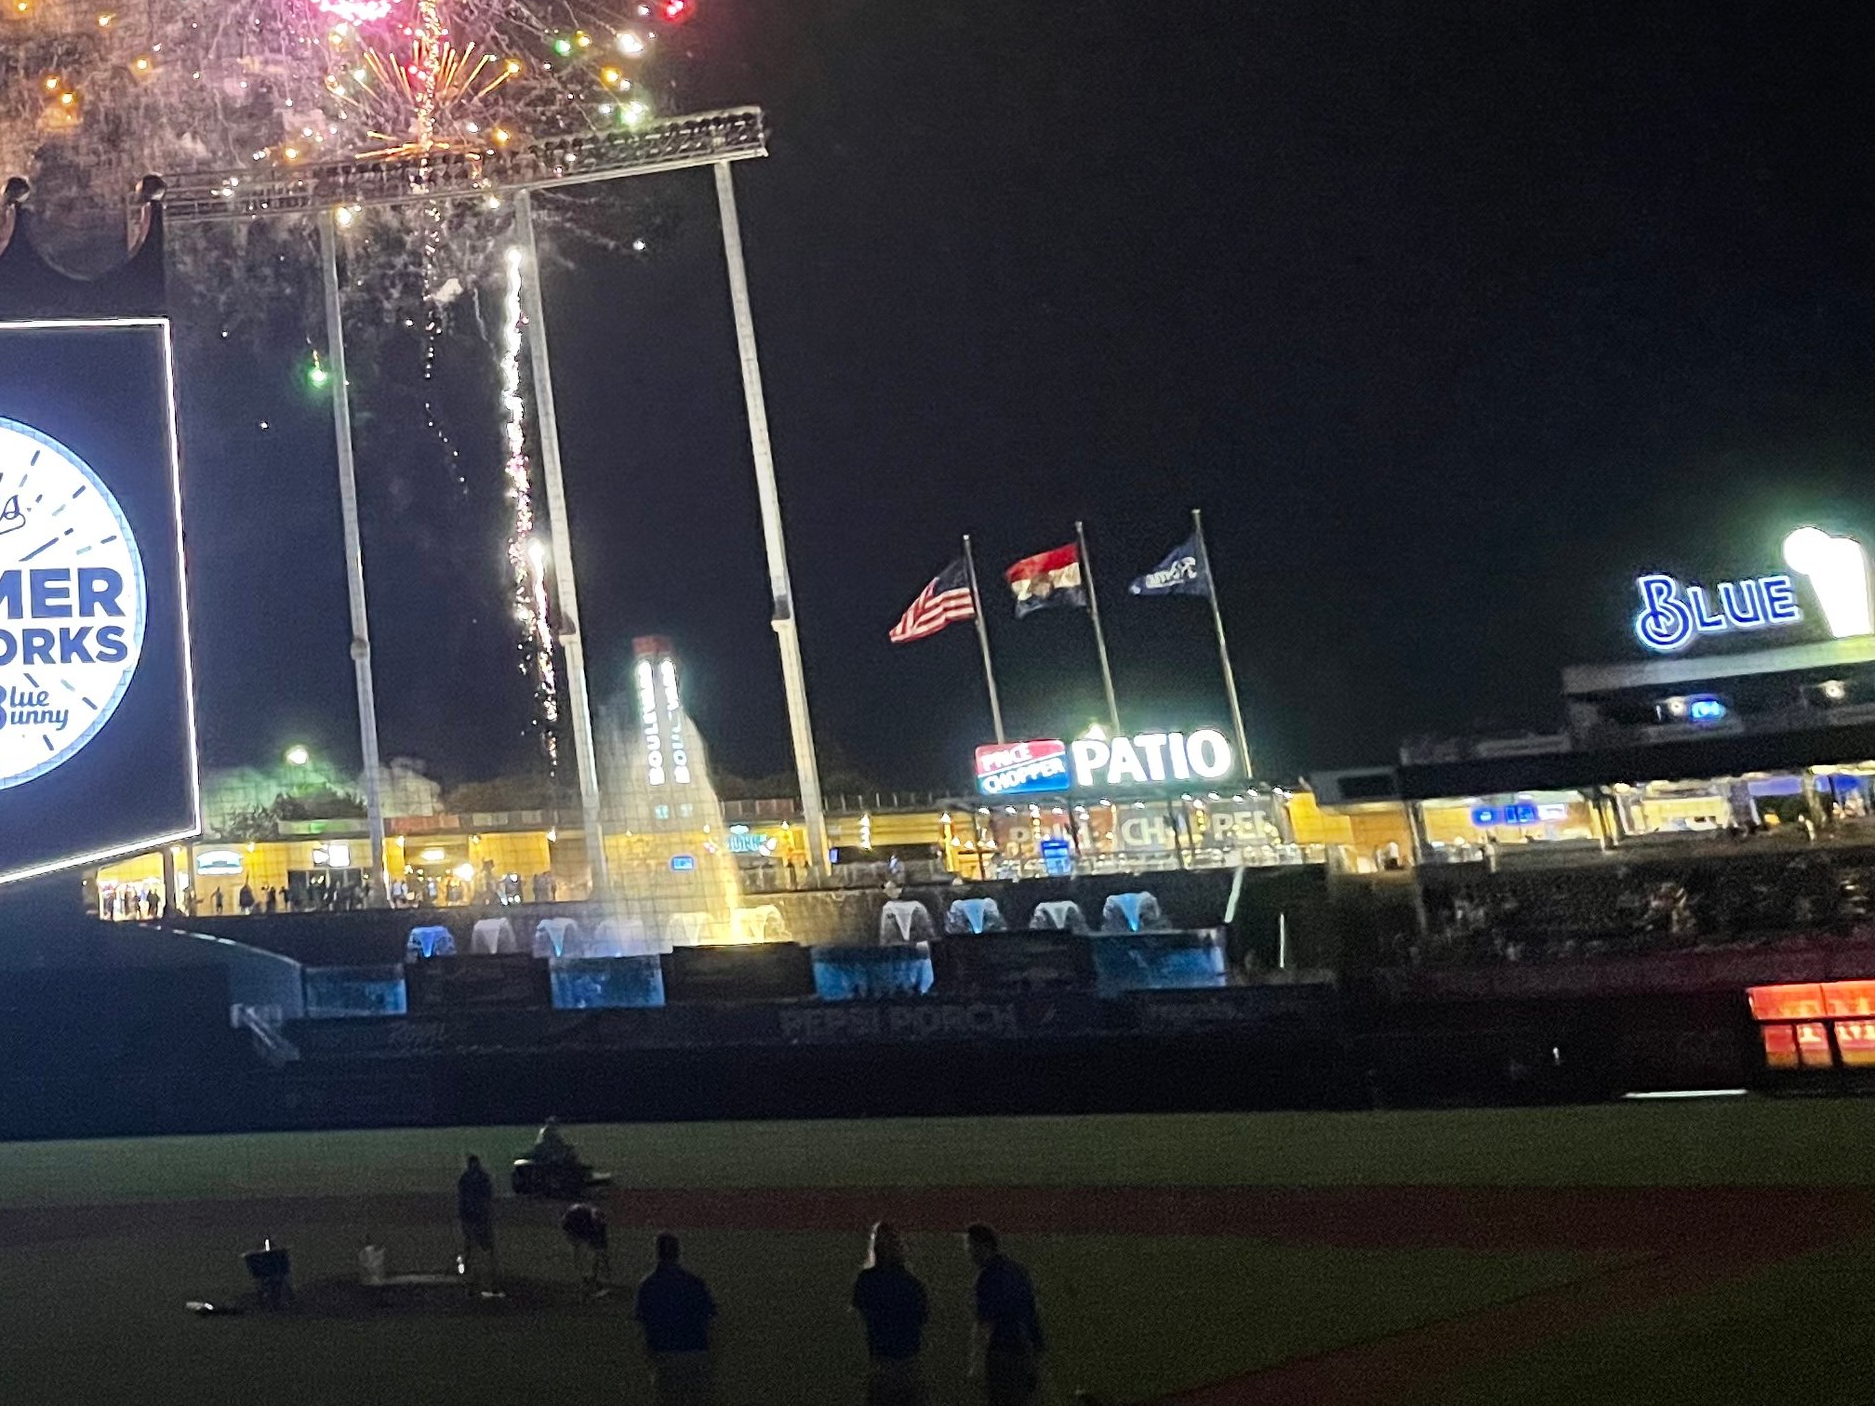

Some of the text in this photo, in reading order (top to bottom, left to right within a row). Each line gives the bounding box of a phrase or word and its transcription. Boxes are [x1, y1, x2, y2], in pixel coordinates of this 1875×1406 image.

[1636, 574, 1802, 650] BLUE
[982, 757, 1066, 794] CHOPPER
[1071, 728, 1232, 787] PATIO
[778, 1002, 1015, 1036] PEPSI PORCH
